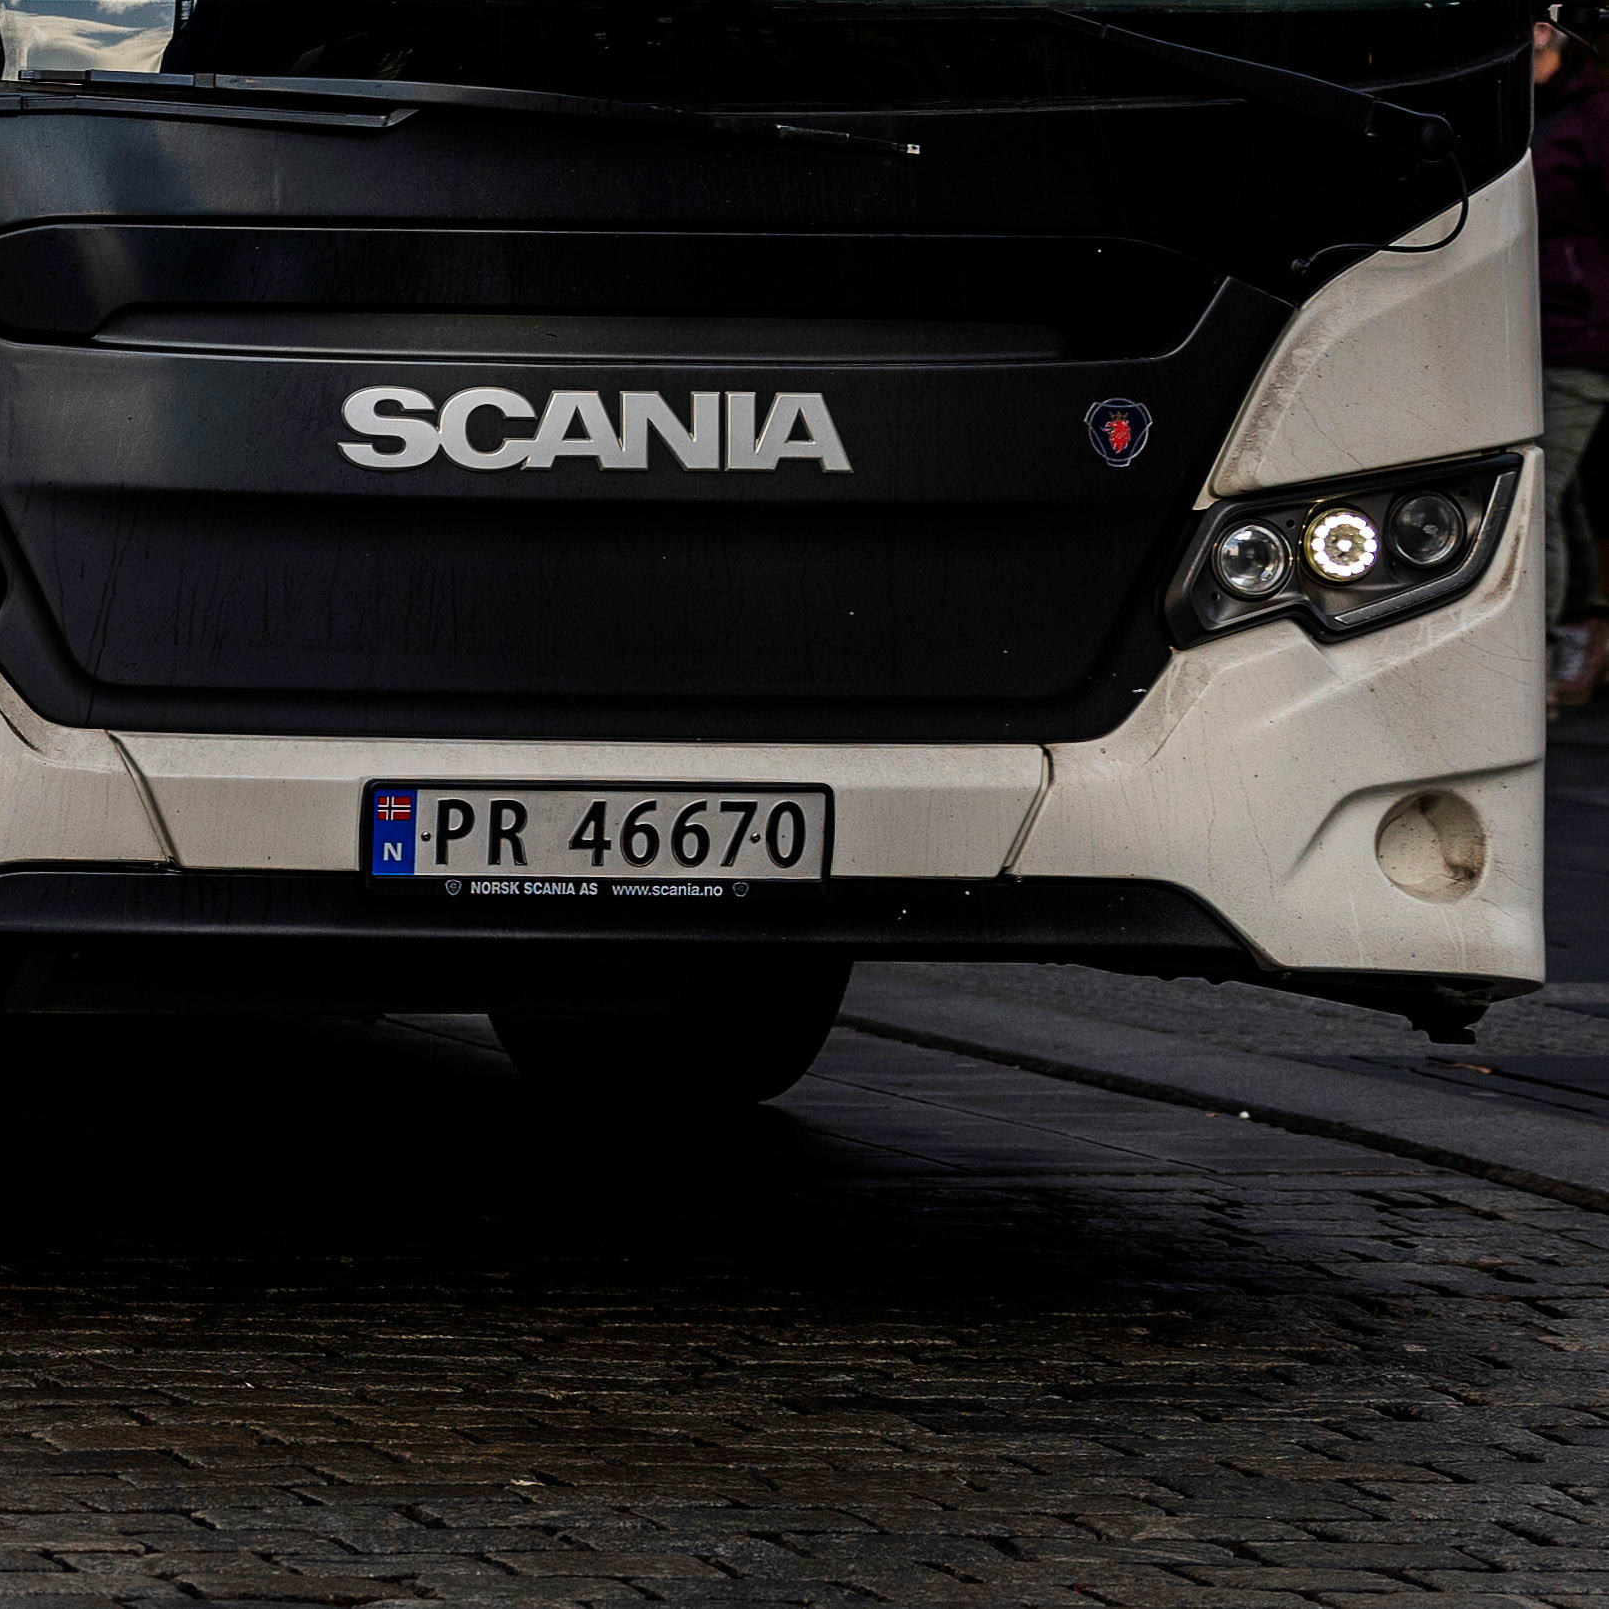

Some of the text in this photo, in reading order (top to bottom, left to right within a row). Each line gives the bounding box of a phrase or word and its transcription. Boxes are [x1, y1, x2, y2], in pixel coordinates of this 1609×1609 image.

[337, 386, 855, 472] SCANIA
[383, 842, 402, 861] N
[435, 798, 806, 868] PR 46670
[470, 881, 724, 897] NORSK SCANIA AS www.scania.no
